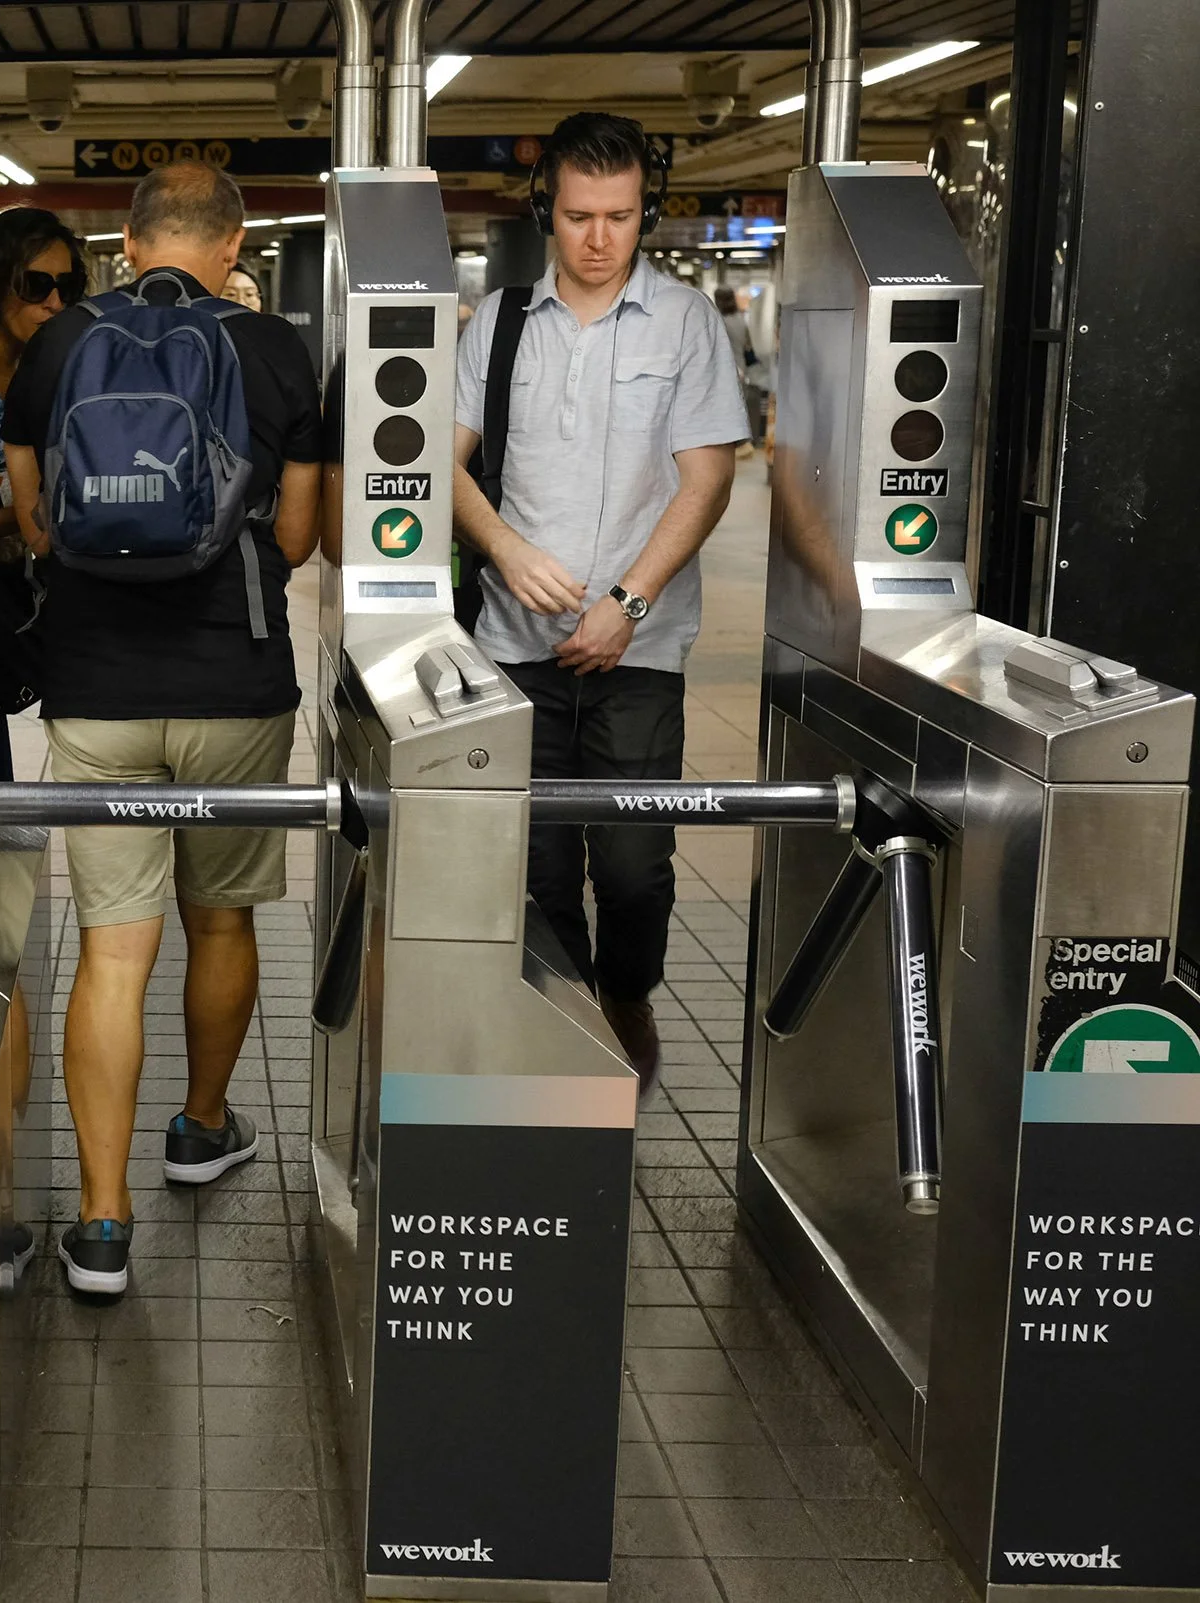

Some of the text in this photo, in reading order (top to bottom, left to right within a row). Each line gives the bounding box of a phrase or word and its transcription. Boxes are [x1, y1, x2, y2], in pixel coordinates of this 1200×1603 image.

[357, 280, 429, 291] wework
[877, 274, 951, 283] wework
[83, 474, 165, 504] PUMA
[367, 475, 429, 499] Entry
[882, 470, 945, 496] Entry
[105, 794, 216, 818] wework
[612, 787, 726, 812] wework
[1053, 938, 1163, 966] Special
[1050, 967, 1127, 995] entry
[909, 952, 938, 1056] wework
[391, 1215, 568, 1236] WORKSPACE
[1029, 1216, 1200, 1235] WORKSPAC
[391, 1250, 512, 1270] FOR THE
[1027, 1252, 1153, 1271] FOR THE
[389, 1285, 512, 1306] WAY YOU
[1024, 1288, 1152, 1307] WAY YOU
[387, 1320, 472, 1340] THINK
[1021, 1323, 1108, 1342] THINK
[380, 1539, 493, 1561] wework
[1004, 1545, 1121, 1568] wework
